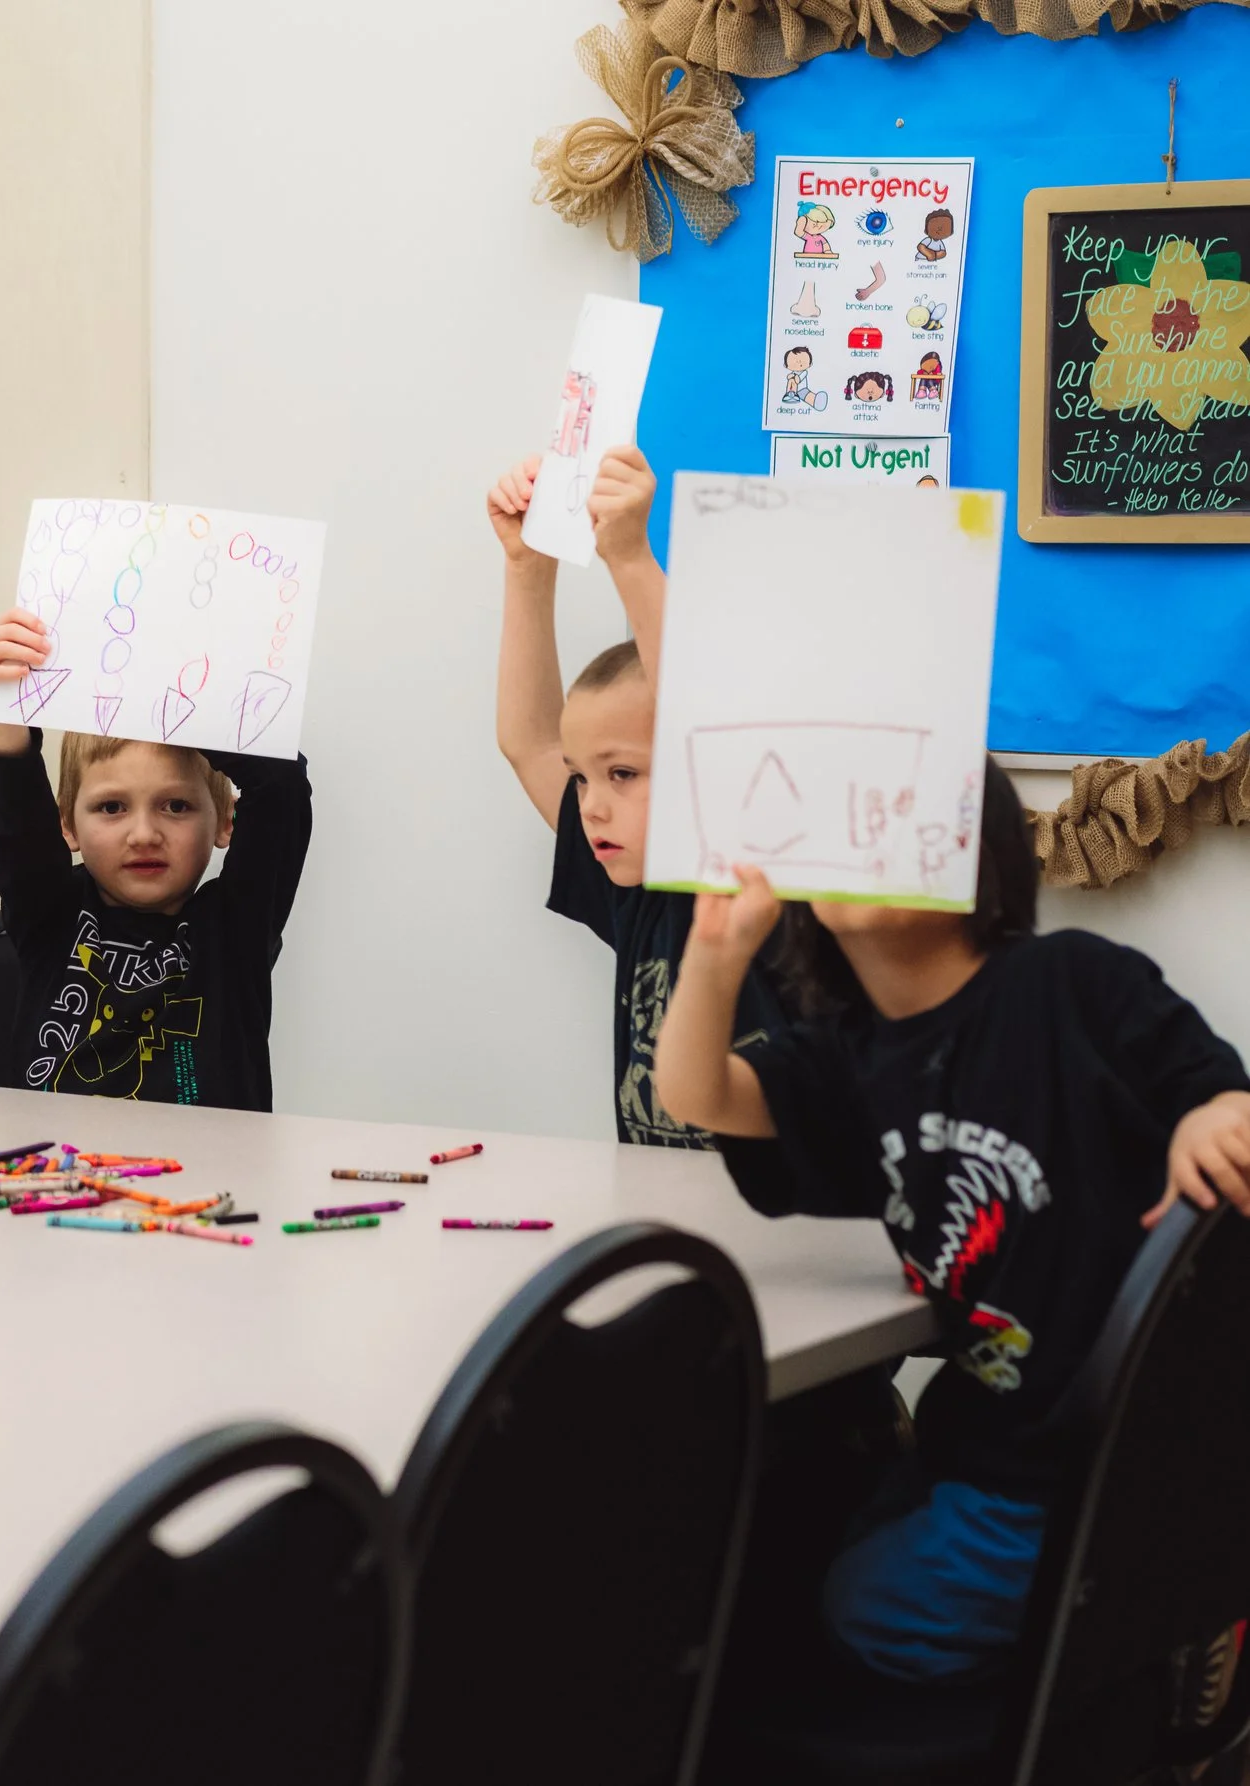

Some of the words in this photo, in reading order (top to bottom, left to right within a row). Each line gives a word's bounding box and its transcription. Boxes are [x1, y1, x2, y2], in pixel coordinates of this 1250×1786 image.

[799, 171, 949, 204] Emergency
[857, 239, 872, 247] eye
[873, 238, 894, 248] injury
[1062, 225, 1125, 273] Keep
[1134, 233, 1228, 281] your
[795, 260, 816, 269] head
[817, 260, 839, 271] injury
[906, 271, 934, 279] stomach
[934, 272, 947, 280] pain
[845, 302, 874, 311] broken
[874, 303, 893, 311] bone
[1058, 268, 1136, 328] face
[1153, 275, 1177, 315] to
[1190, 278, 1250, 315] the
[784, 327, 825, 337] nosebleed
[791, 318, 819, 326] severe
[912, 331, 925, 340] bee
[927, 332, 944, 341] sting
[1056, 359, 1115, 389] and
[1125, 359, 1166, 400] you
[776, 407, 796, 416] deep
[798, 406, 812, 415] cut
[852, 403, 882, 411] asthma
[1113, 388, 1163, 422] the
[1172, 386, 1250, 421] shado
[853, 413, 879, 421] attack
[1067, 429, 1120, 455] It's
[1132, 423, 1205, 457] what
[801, 444, 843, 469] Not
[851, 444, 930, 475] Urgent
[1213, 450, 1249, 486] do
[1124, 486, 1169, 513] Helen
[1177, 487, 1241, 511] Keller
[173, 1041, 181, 1065] BATTLE
[186, 1040, 195, 1070] PIKACHU
[190, 1075, 198, 1094] SUPER
